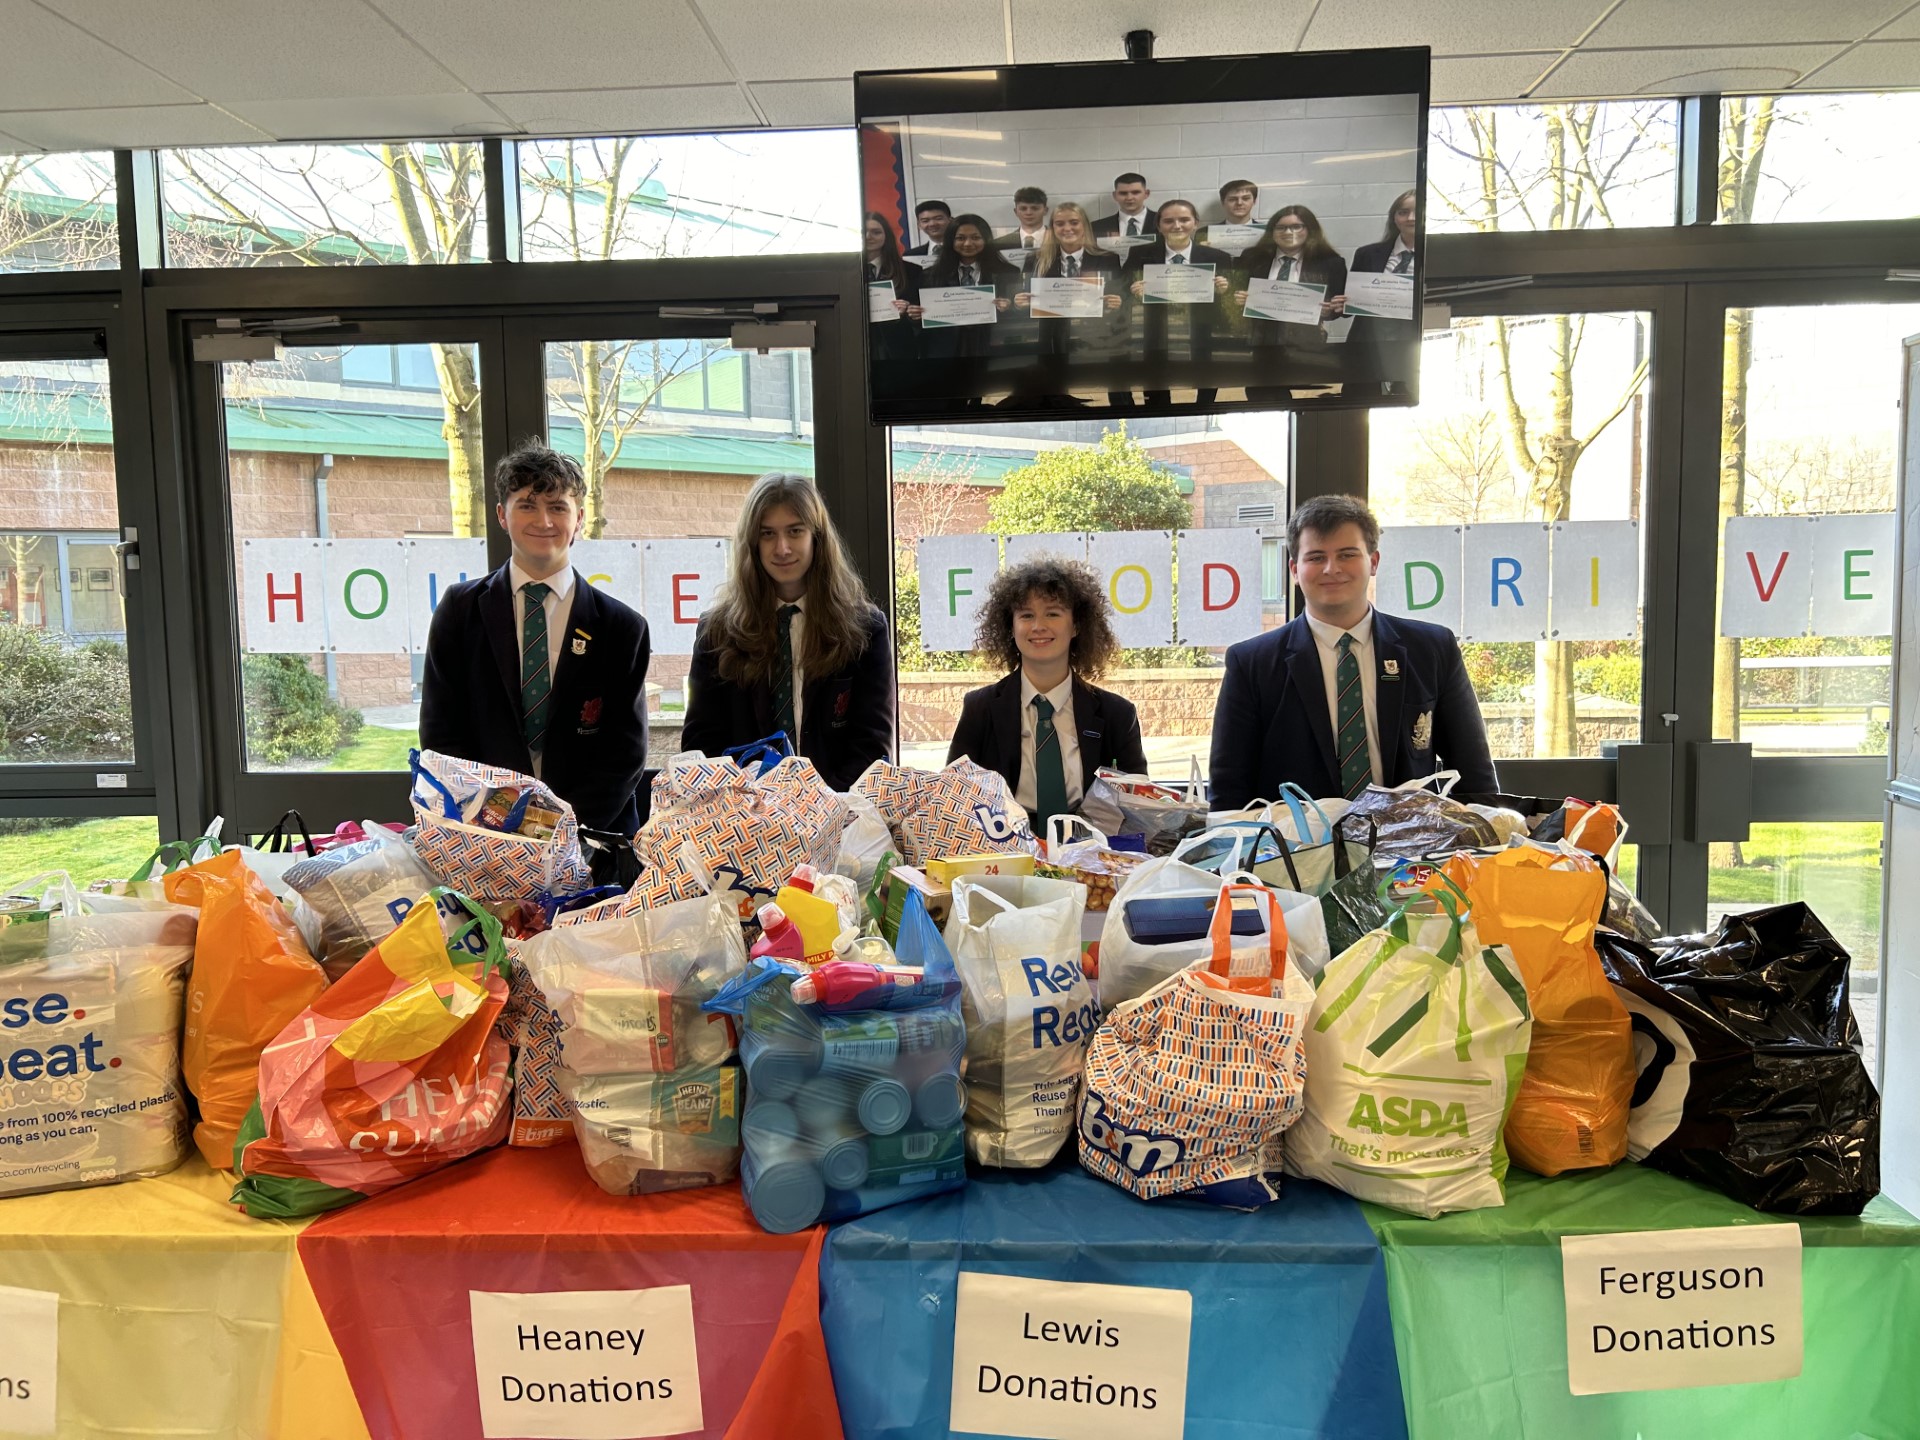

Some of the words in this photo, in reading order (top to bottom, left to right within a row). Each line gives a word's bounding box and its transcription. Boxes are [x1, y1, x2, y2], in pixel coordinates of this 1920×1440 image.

[948, 563, 1241, 617] FOD
[1405, 550, 1874, 611] DRIVE
[985, 864, 999, 876] 24
[0, 1032, 122, 1081] eat.
[678, 1099, 711, 1110] BEANZ
[681, 1085, 707, 1096] HEINZ
[1033, 1091, 1066, 1103] Reuse
[7, 1116, 39, 1128] from
[42, 1110, 78, 1124] 100%
[81, 1100, 136, 1119] recycled
[140, 1091, 178, 1111] plastic.
[1034, 1107, 1062, 1117] Then
[1346, 1092, 1471, 1138] ASDA
[26, 1132, 40, 1142] as
[43, 1129, 66, 1143] you
[69, 1125, 97, 1135] can.
[1329, 1134, 1381, 1162] That's
[1600, 1266, 1764, 1300] Ferguson
[517, 1324, 645, 1356] Heaney
[1023, 1312, 1119, 1348] Lewis
[1592, 1319, 1775, 1354] Donations
[501, 1371, 673, 1403] Donations
[978, 1365, 1157, 1410] Donations
